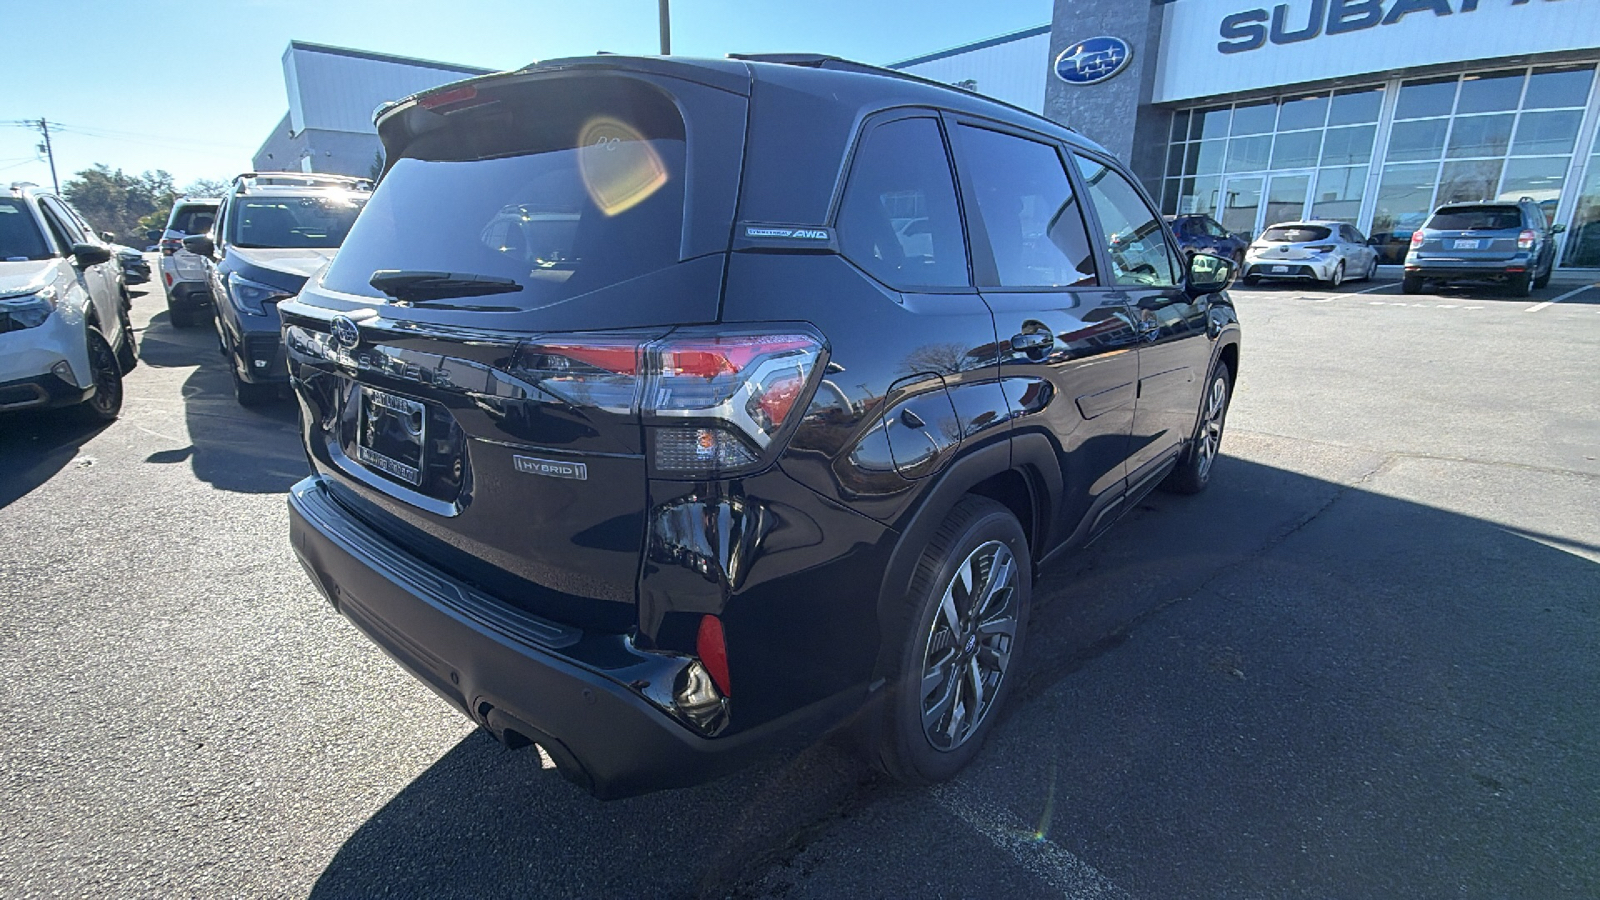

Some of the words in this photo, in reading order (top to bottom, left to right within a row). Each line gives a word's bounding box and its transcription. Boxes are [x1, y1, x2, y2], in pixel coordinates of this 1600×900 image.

[1217, 0, 1571, 54] SUBA
[792, 230, 828, 239] AWD
[523, 461, 573, 475] HYBRID
